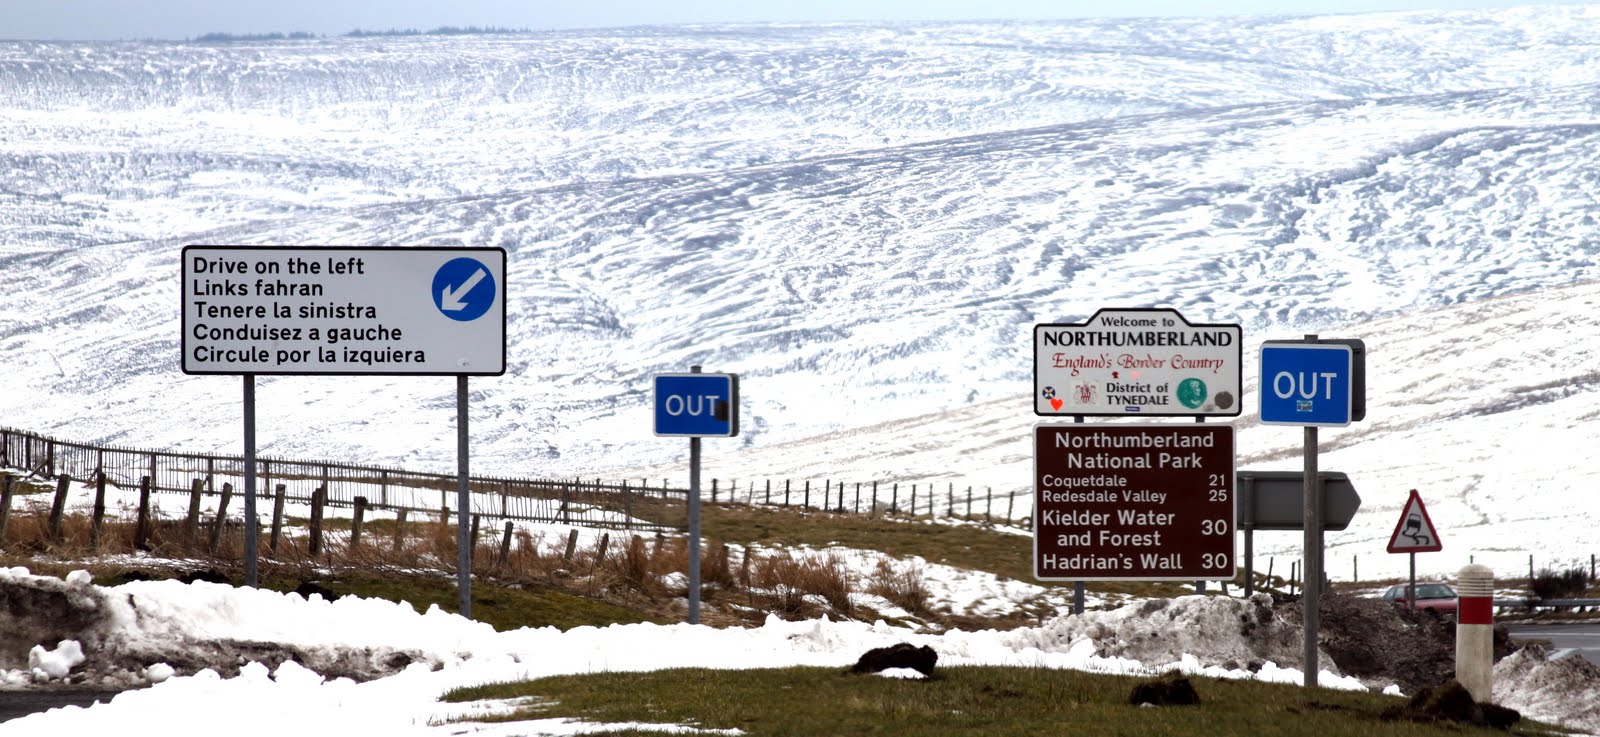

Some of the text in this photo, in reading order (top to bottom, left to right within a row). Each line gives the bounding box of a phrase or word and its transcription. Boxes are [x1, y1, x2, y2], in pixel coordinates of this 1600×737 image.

[194, 257, 364, 274] Drive on the left
[194, 280, 323, 296] Links fahran
[194, 302, 376, 319] Tenere la sinistra
[1101, 317, 1175, 326] Welcome to
[194, 324, 402, 344] Conduisez a gauche
[1044, 331, 1232, 346] NORTHUMBERLAND
[194, 347, 425, 366] Circule por la izquiera
[1052, 352, 1223, 376] England's Border Country
[1107, 382, 1168, 393] District of
[1274, 371, 1337, 399] OUT
[666, 395, 720, 416] OUT
[1107, 395, 1169, 405] TYNEDALE
[1056, 432, 1214, 448] Northumberland
[1068, 453, 1203, 468] National Park
[1043, 474, 1225, 488] Coquetdale 21
[1043, 490, 1227, 504] Redesdale Valley 25
[1043, 510, 1175, 525] Kielder Water
[1201, 520, 1227, 535] 30
[1057, 531, 1161, 546] and Forest
[1043, 553, 1227, 569] Hadrian's Wall 30
